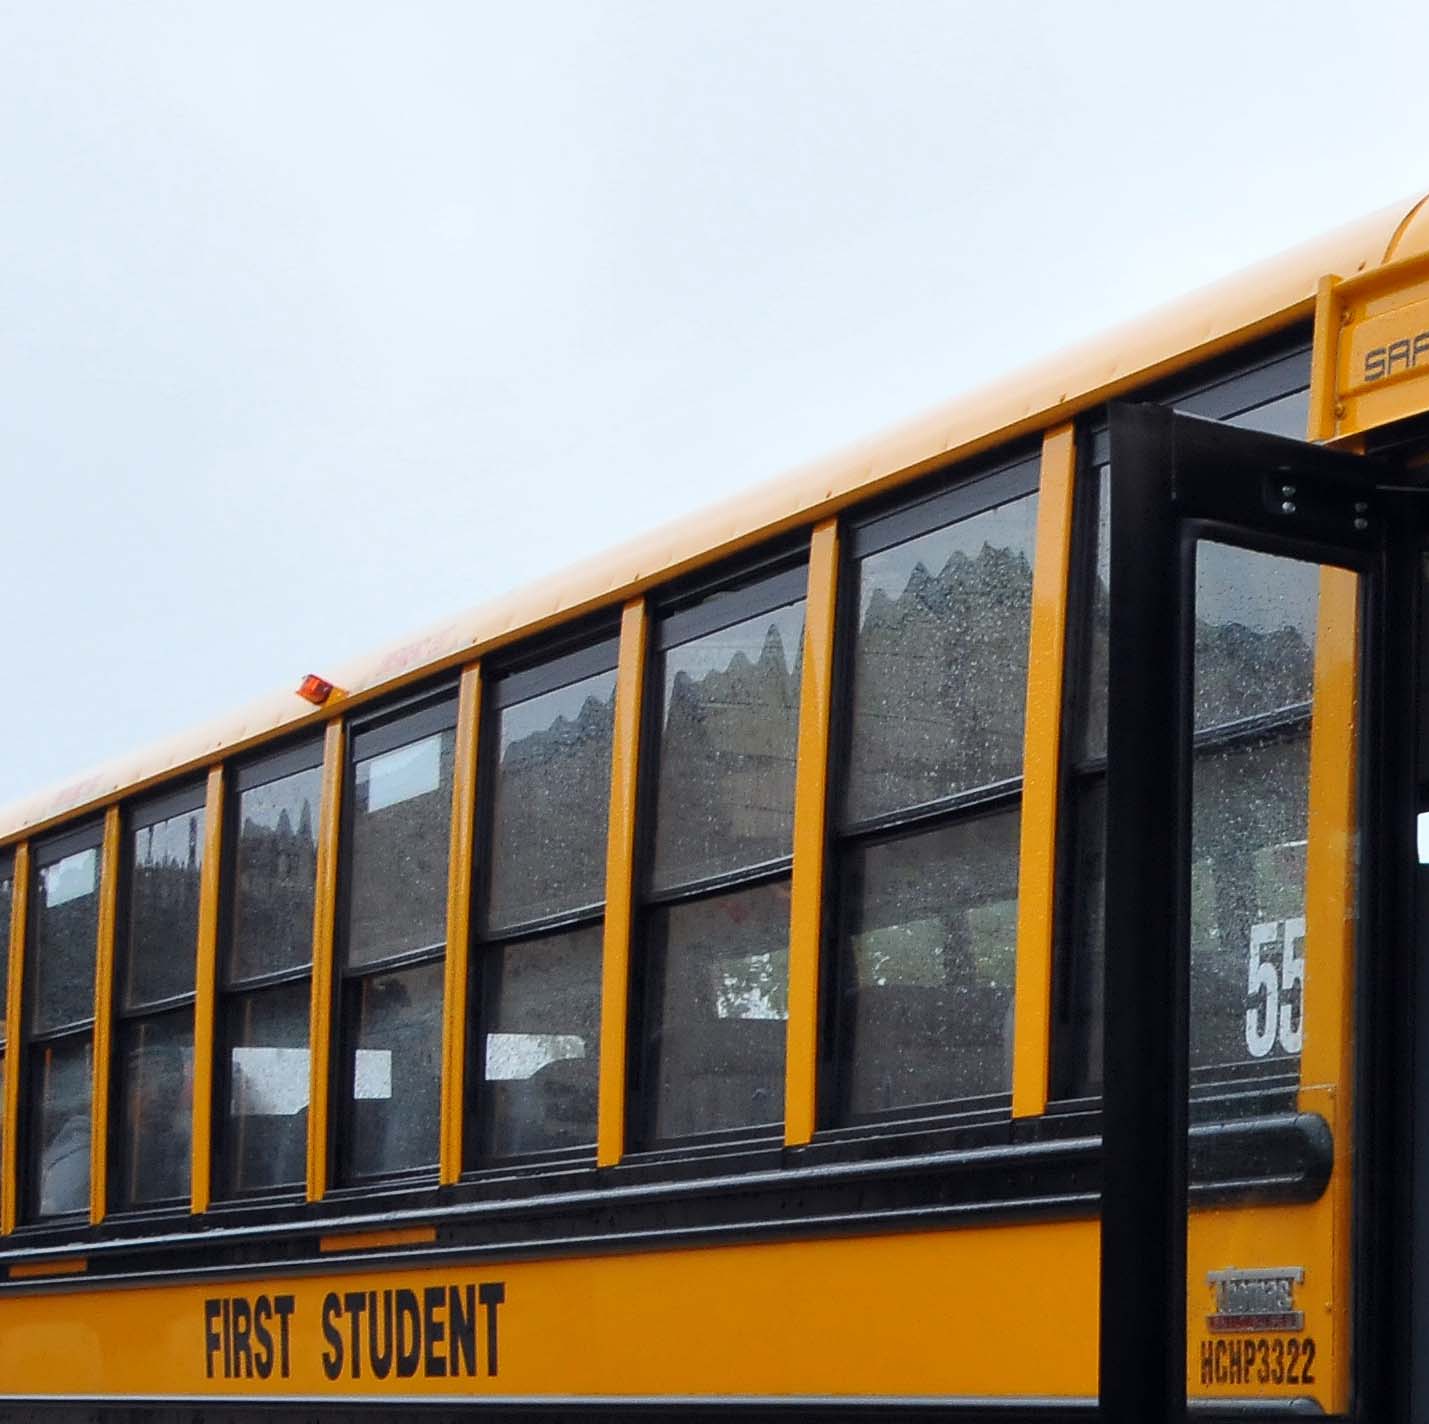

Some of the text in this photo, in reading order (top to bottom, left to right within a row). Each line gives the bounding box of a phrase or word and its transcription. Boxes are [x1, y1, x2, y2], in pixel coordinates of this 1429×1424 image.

[1245, 917, 1306, 1057] 55
[204, 1282, 506, 1381] FIRST STUDENT
[1200, 1338, 1316, 1385] HCHP3322
